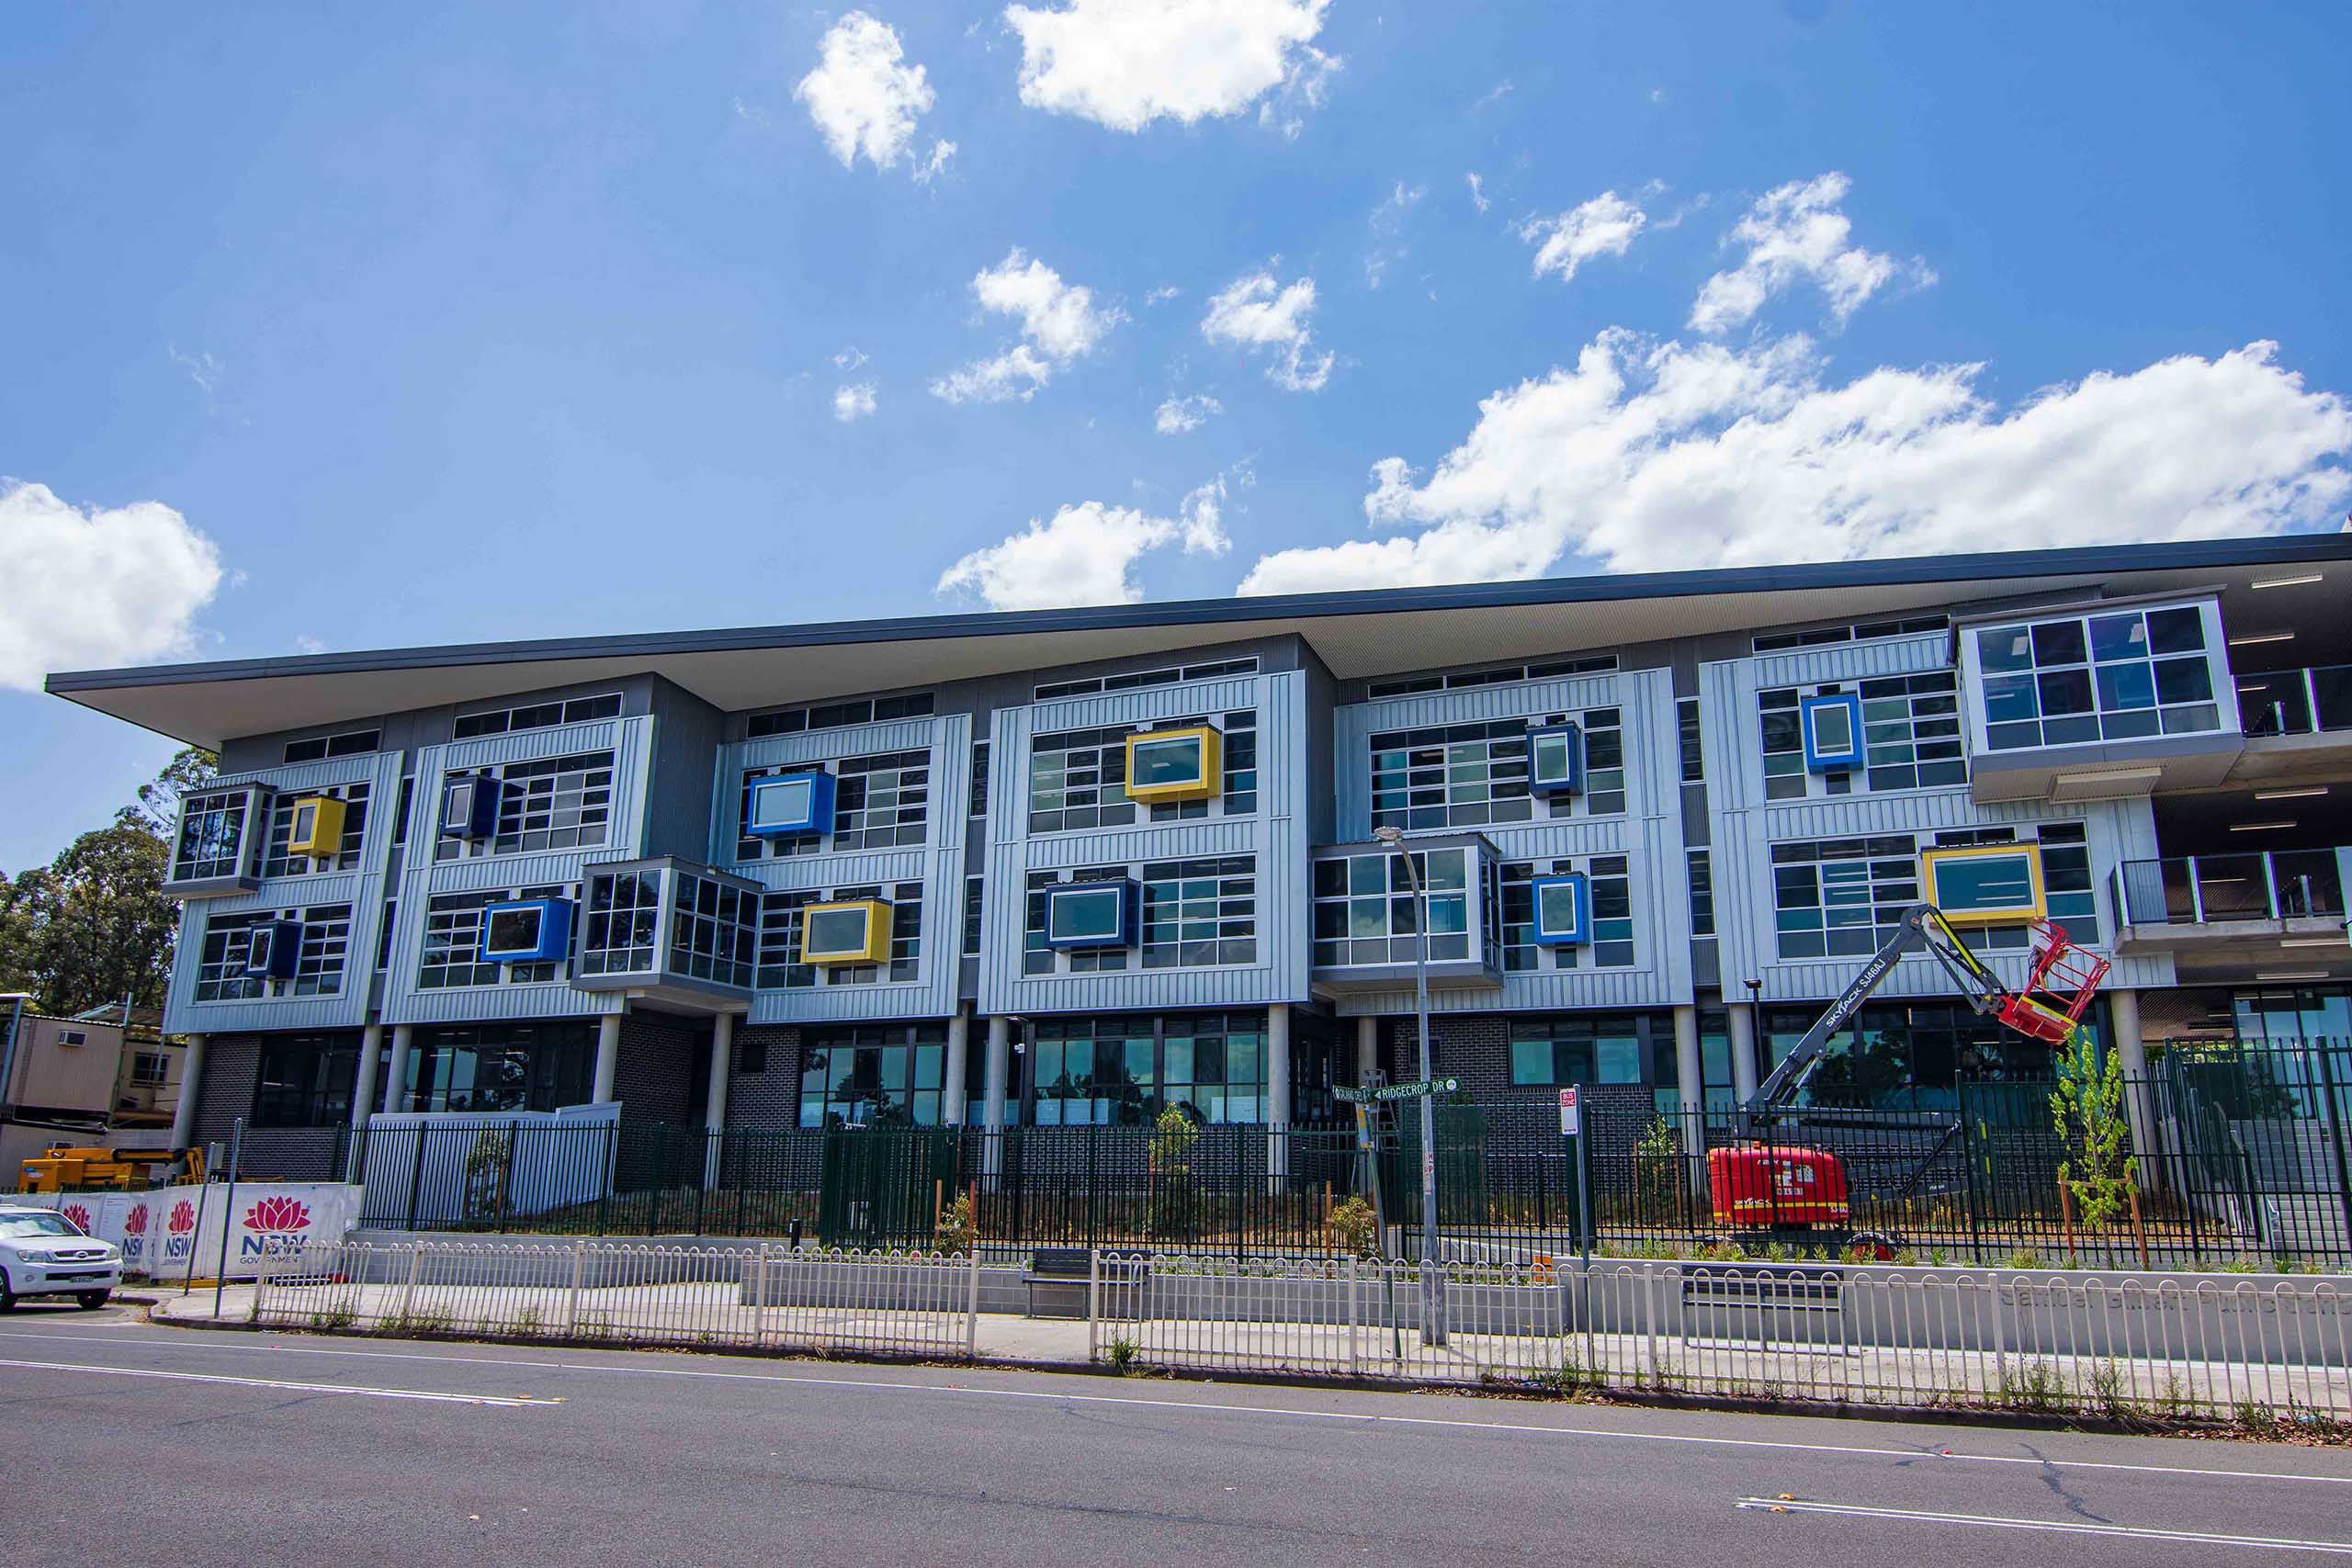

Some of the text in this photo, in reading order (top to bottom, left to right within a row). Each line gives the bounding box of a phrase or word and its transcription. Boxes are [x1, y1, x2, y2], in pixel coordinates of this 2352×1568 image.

[1826, 958, 1886, 1027] SKYJACK SJ46AJ
[1382, 1080, 1444, 1100] RIDGECROP DR
[164, 1236, 192, 1258] NSW
[241, 1235, 308, 1255] NSW
[239, 1256, 303, 1265] GOVNMENT
